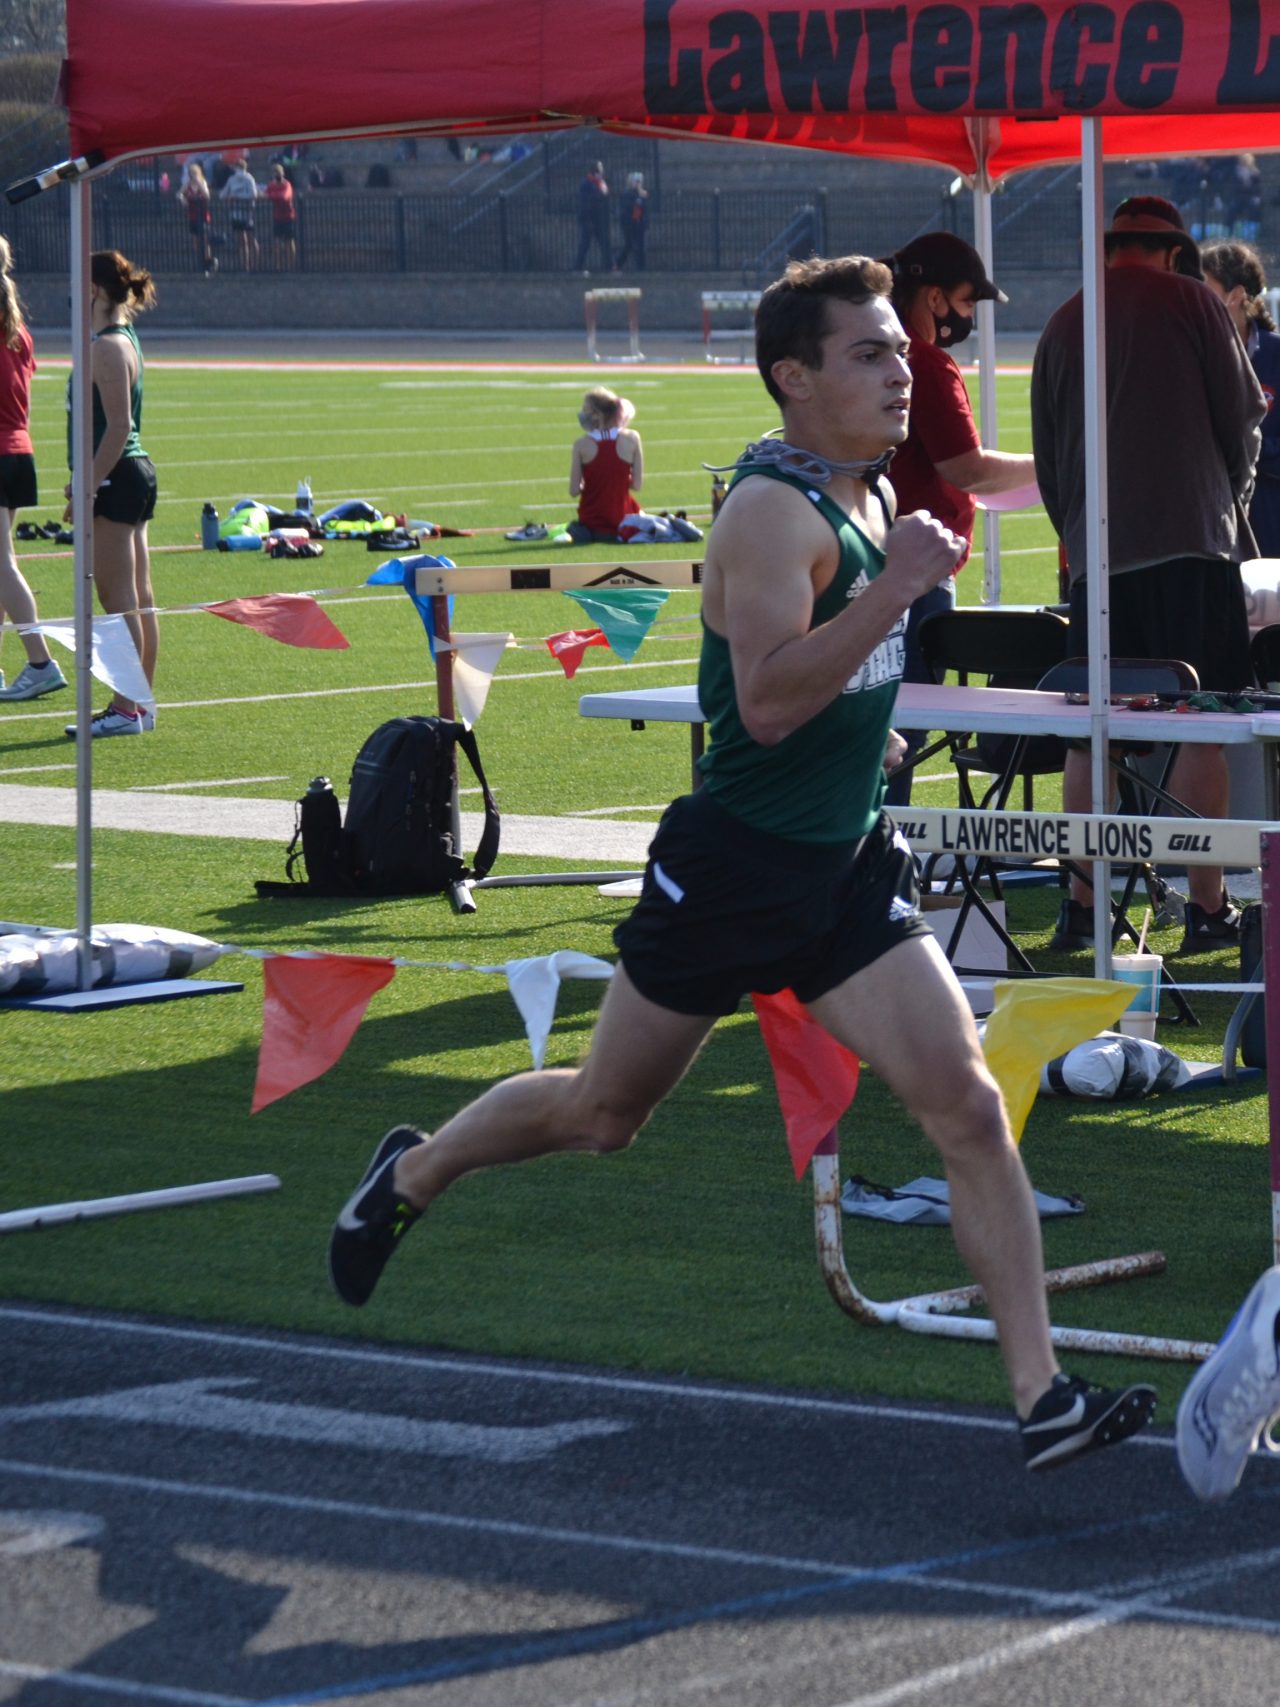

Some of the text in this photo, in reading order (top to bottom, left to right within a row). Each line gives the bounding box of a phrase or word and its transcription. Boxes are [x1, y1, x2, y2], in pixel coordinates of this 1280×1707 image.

[643, 0, 1184, 114] Lawrence
[897, 815, 1211, 858] ILL LAWRENCE LIONS GILL
